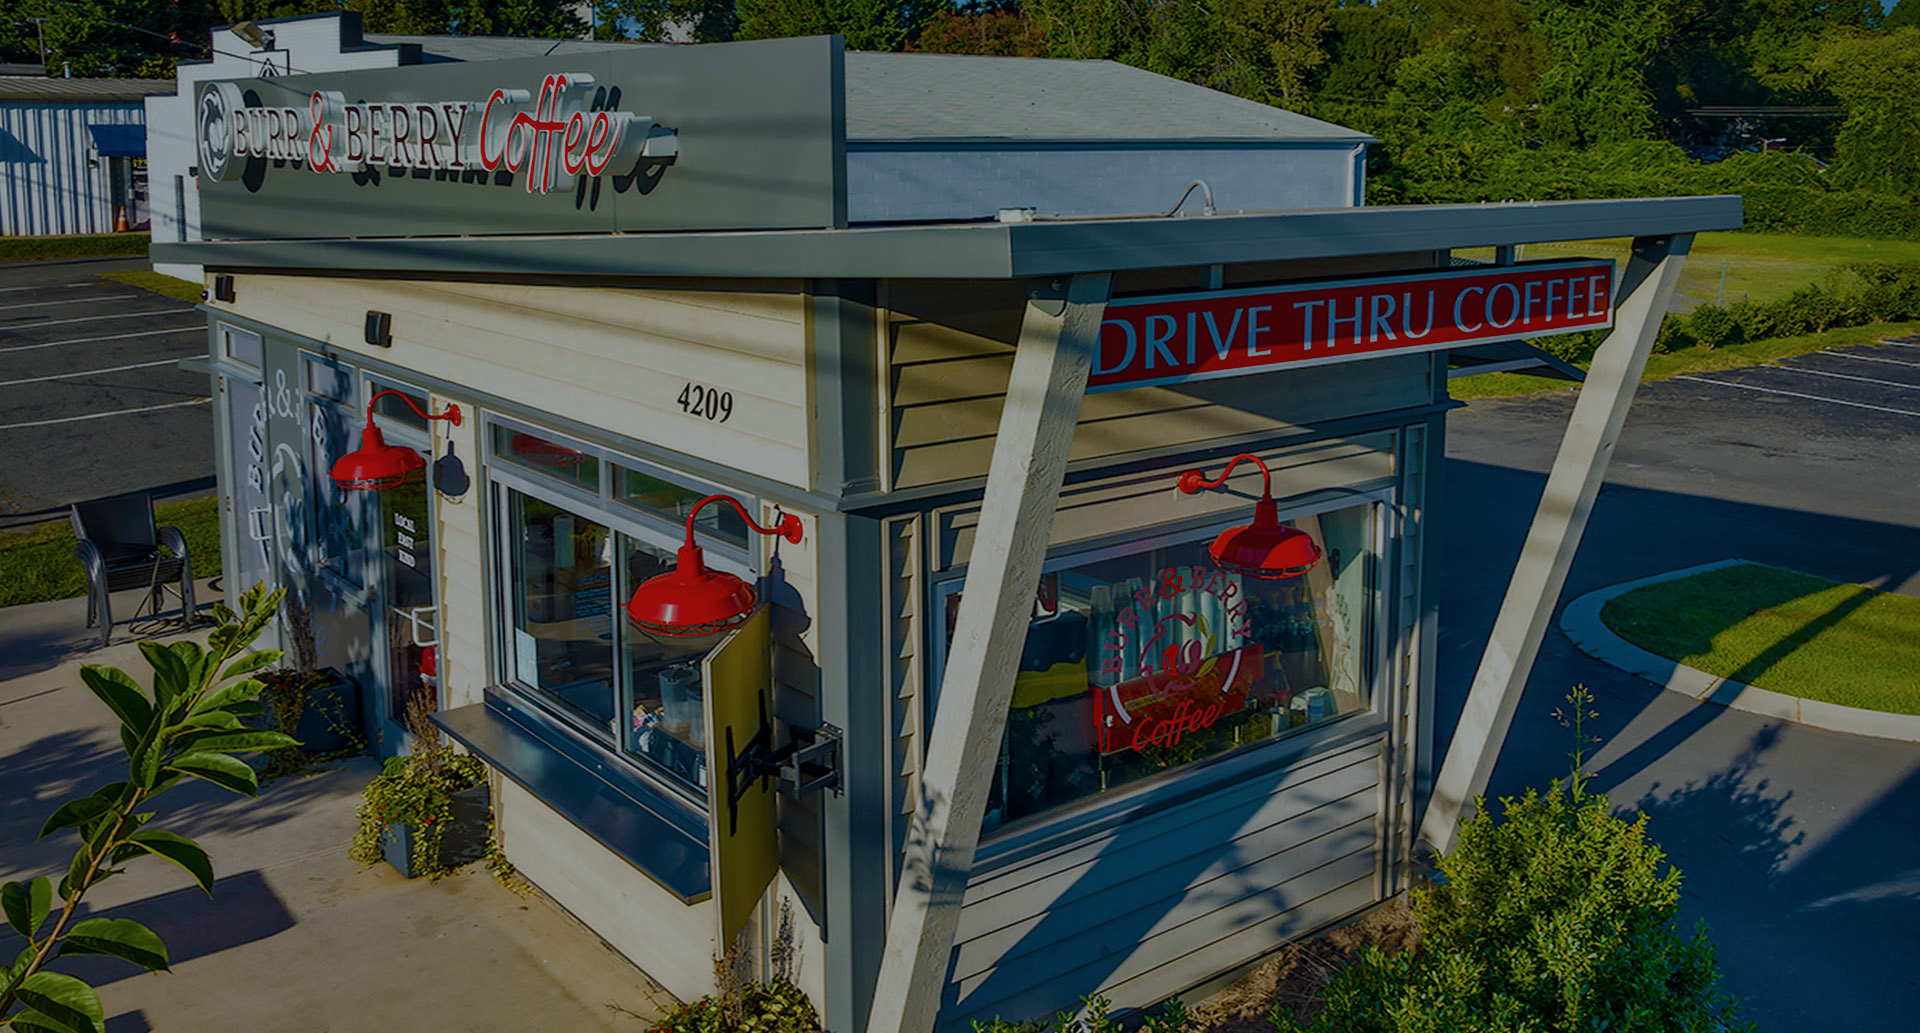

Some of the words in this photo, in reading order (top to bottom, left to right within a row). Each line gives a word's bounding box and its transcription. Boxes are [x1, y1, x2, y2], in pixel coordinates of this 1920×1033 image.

[232, 108, 302, 160] BURR
[309, 90, 337, 174] &
[345, 104, 469, 170] BERRY
[480, 73, 620, 195] Coffee
[1093, 305, 1272, 375] DRIVE
[1292, 289, 1436, 352] THRU
[1453, 274, 1608, 333] COFFEE
[677, 382, 733, 424] 4209
[1103, 587, 1158, 677] BURR
[1160, 566, 1187, 600] &
[1190, 566, 1251, 640] BERRY
[1131, 698, 1224, 752] Coffee
